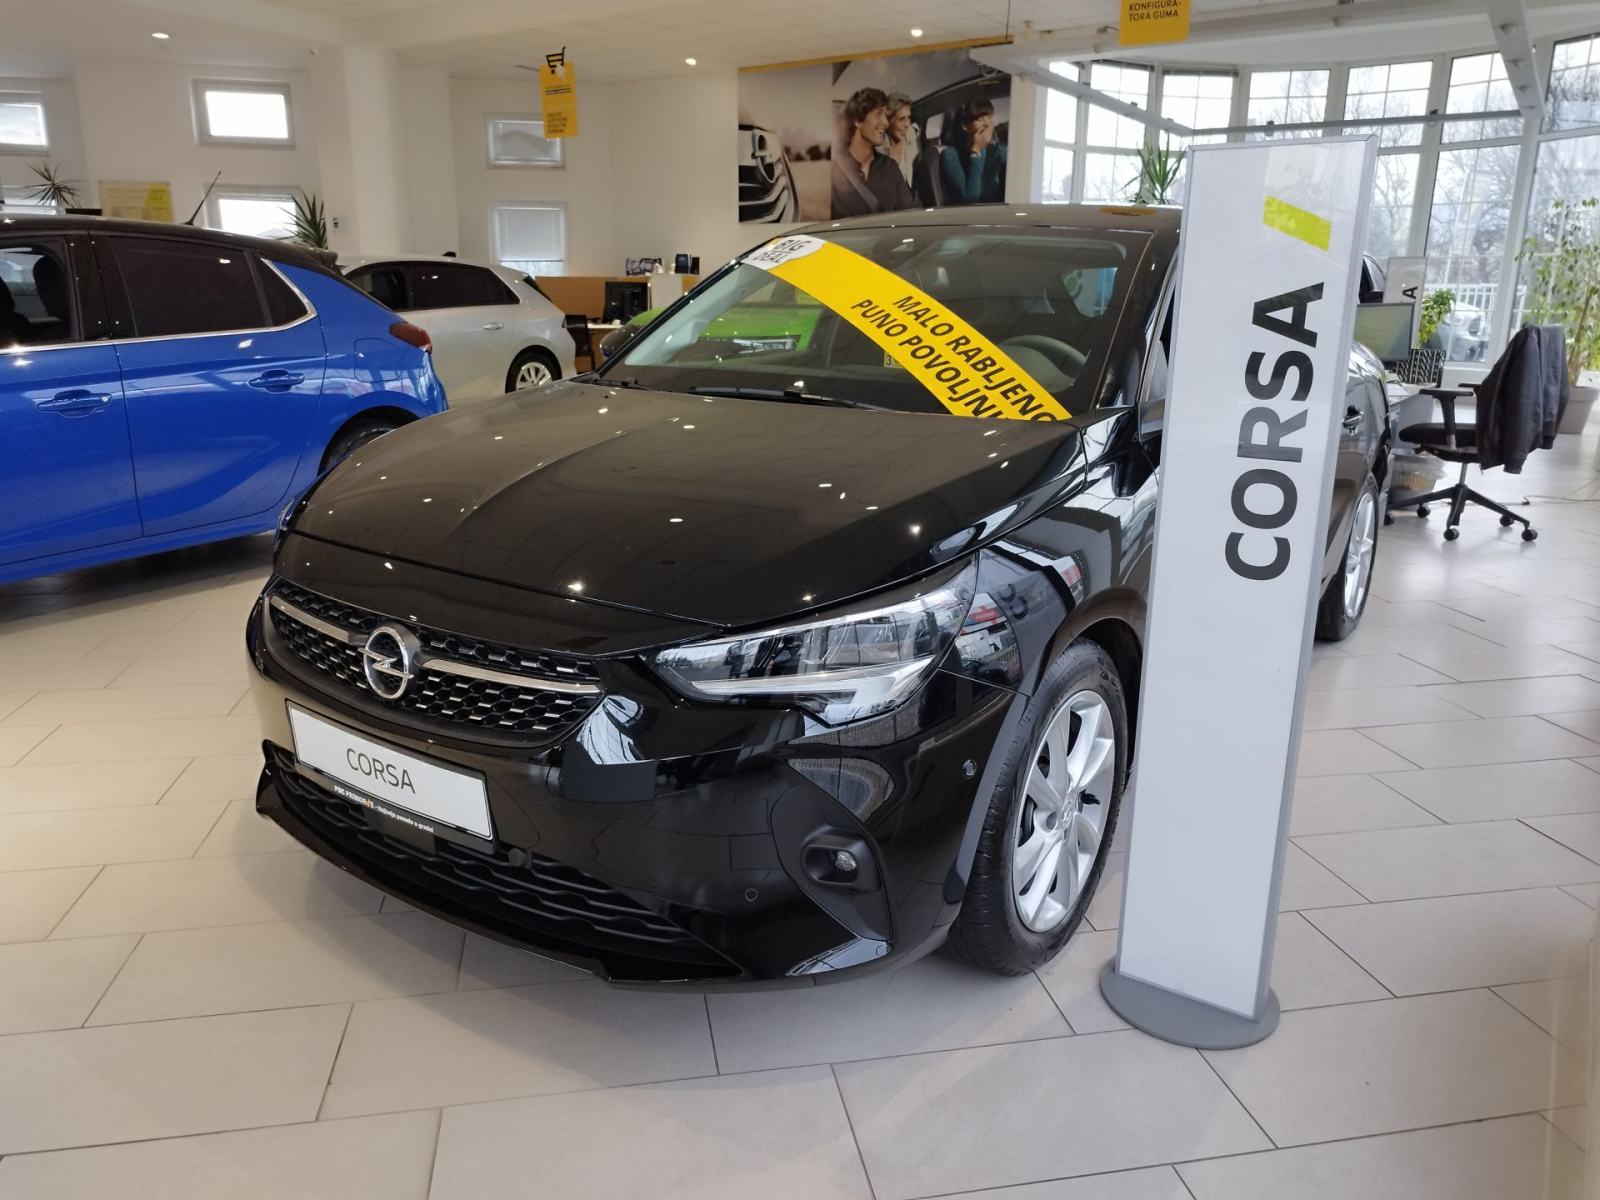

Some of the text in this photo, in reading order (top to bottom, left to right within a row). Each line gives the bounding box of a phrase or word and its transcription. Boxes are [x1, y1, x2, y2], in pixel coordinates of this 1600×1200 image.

[1129, 0, 1181, 11] KONFIGURA-
[1129, 9, 1179, 21] TORA GUMA
[774, 239, 812, 252] BIG
[851, 299, 908, 337] PUNO
[892, 295, 1058, 421] MALO RABLJENO
[1225, 282, 1325, 581] CORSA
[346, 748, 415, 794] CORSA
